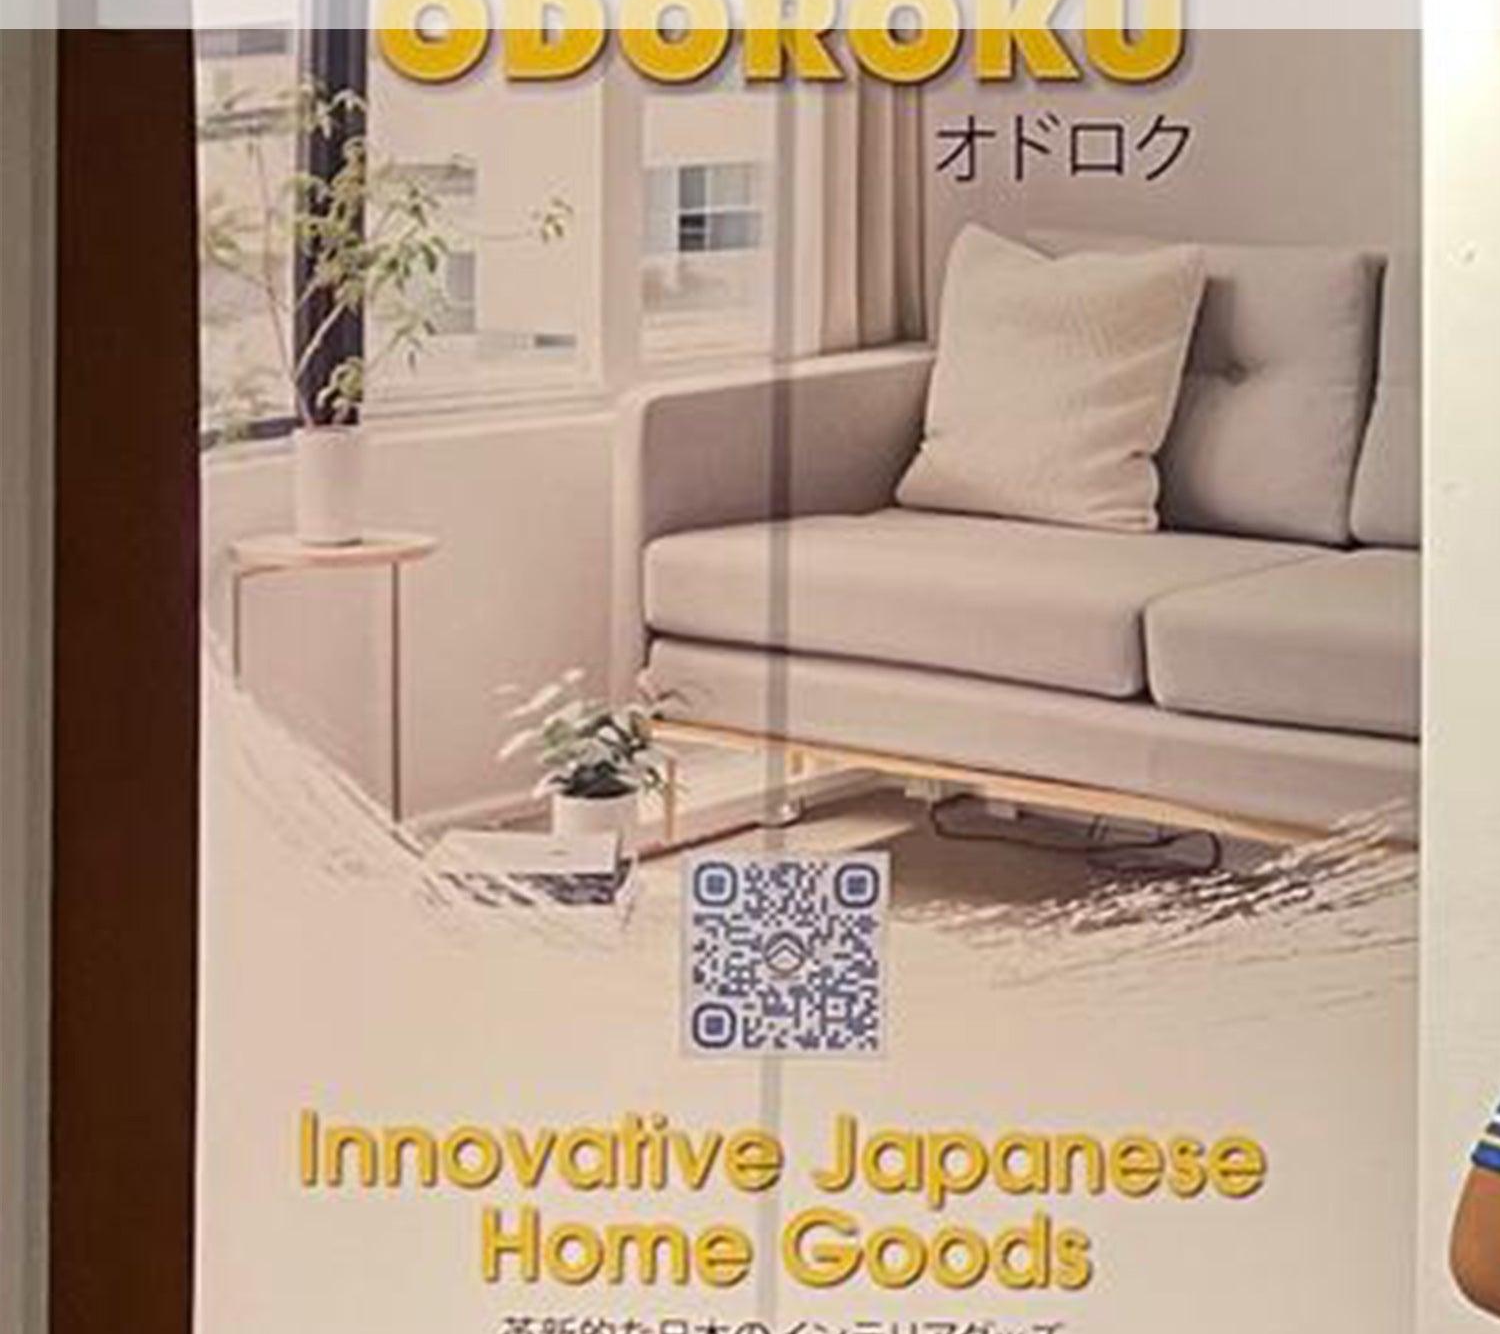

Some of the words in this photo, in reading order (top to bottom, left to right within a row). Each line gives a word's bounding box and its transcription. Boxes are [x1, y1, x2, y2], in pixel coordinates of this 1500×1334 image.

[937, 114, 1193, 182] オドロク
[298, 1108, 784, 1195] Innovative
[813, 1113, 1266, 1212] Japanese
[480, 1206, 753, 1286] Home
[782, 1210, 1094, 1292] Goods
